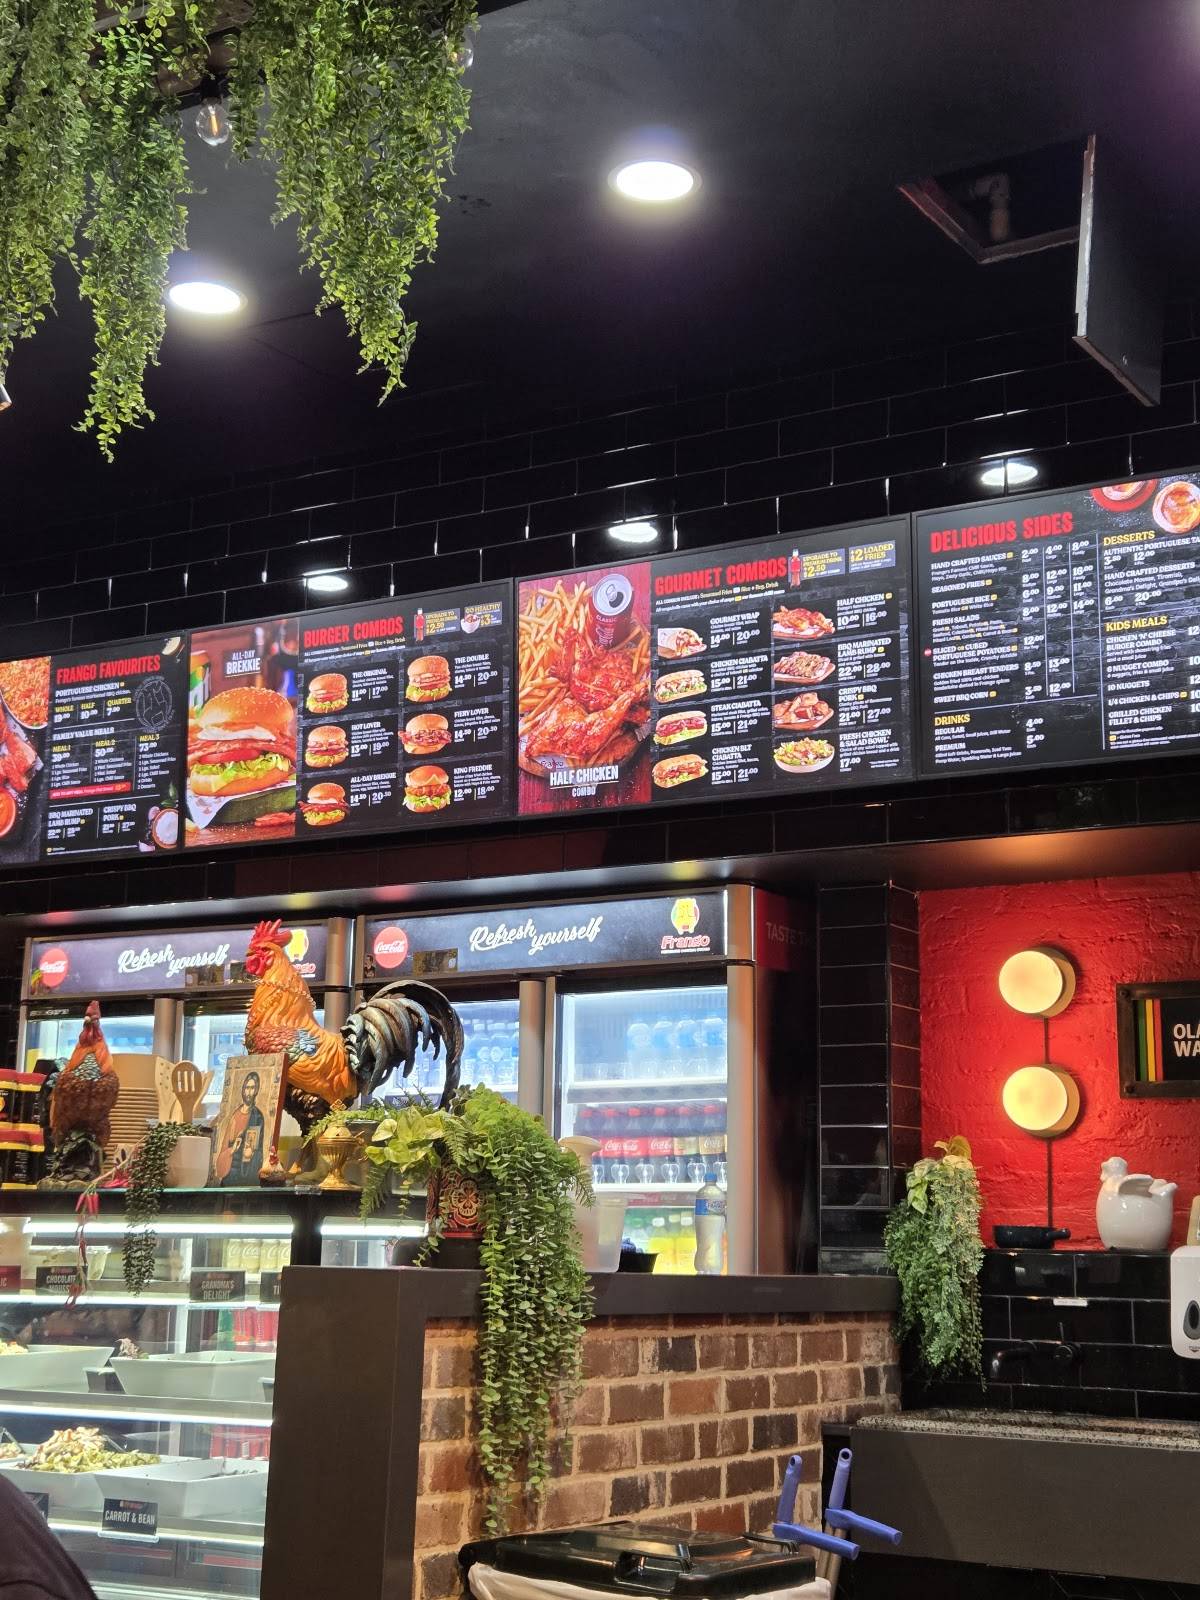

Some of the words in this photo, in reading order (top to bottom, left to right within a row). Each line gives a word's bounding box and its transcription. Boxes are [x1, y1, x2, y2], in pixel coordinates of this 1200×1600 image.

[931, 521, 1016, 553] DELICIOUS
[1023, 512, 1072, 538] SIDES
[1103, 530, 1154, 546] DESSERTS
[864, 543, 893, 553] LOADED
[1104, 544, 1143, 556] AUTHENTIC
[1144, 537, 1190, 550] PORTUGUESE
[864, 551, 885, 560] FRIES
[931, 561, 949, 569] HAND
[951, 556, 979, 566] CRAFTED
[981, 552, 1005, 562] SAUCES
[656, 567, 722, 595] GOURMET
[726, 556, 787, 585] COMBOS
[1104, 571, 1124, 580] HAND
[1126, 566, 1157, 577] CRAFTED
[1159, 561, 1195, 572] DESSERTS
[931, 582, 965, 593] SEASONED
[837, 598, 854, 606] HALF
[855, 593, 884, 603] CHICKEN
[710, 614, 740, 625] GOURMET
[741, 611, 759, 620] WRAP
[837, 614, 858, 626] 10.00
[865, 610, 886, 622] 16.00
[932, 617, 952, 626] FRESH
[1106, 620, 1130, 631] KIDS
[1132, 615, 1167, 628] MEALS
[304, 625, 349, 648] BURGER
[354, 616, 403, 640] COMBOS
[736, 629, 759, 640] 20.00
[1106, 633, 1136, 643] CHICKEN
[1148, 629, 1175, 638] CHEESE
[852, 637, 890, 648] MARINATED
[933, 645, 956, 654] SLICED
[965, 641, 987, 650] CUBED
[1106, 641, 1134, 650] BURGER
[1135, 638, 1162, 647] COMBO
[232, 650, 255, 660] ALL-DAY
[976, 645, 1010, 655] POTATOES
[227, 658, 260, 674] BREKKIE
[711, 658, 737, 668] CHICKEN
[866, 661, 890, 673] 28.00
[1113, 662, 1140, 671] NUGGET
[1142, 659, 1168, 668] COMBO
[56, 665, 96, 684] FRANGO
[100, 655, 160, 679] FAVOURITES
[838, 665, 862, 676] 22.00
[933, 670, 961, 679] CHICKEN
[737, 674, 756, 685] 21.00
[1116, 680, 1149, 690] NUGGETS
[838, 686, 861, 695] CRISPY
[838, 694, 857, 702] PORK
[934, 695, 954, 703] SWEET
[1118, 695, 1150, 704] CHICKEN
[711, 703, 731, 712] STEAK
[867, 707, 890, 718] 27.00
[1108, 709, 1138, 718] GRILLED
[1139, 705, 1171, 714] CHICKEN
[737, 719, 757, 729] 21.00
[934, 713, 970, 725] DRINKS
[839, 732, 860, 740] FRESH
[862, 729, 891, 738] CHICKEN
[935, 726, 964, 735] REGULAR
[844, 738, 866, 747] SALAD
[935, 742, 965, 751] PREMIUM
[839, 757, 860, 768] 17.00
[550, 769, 575, 786] HALF
[577, 765, 618, 783] CHICKEN
[737, 767, 757, 778] 21.00
[572, 786, 596, 797] COMBO
[469, 918, 536, 952] Refresh
[530, 916, 604, 954] yourself
[661, 935, 710, 950] Frango
[118, 944, 175, 974] Refresh
[168, 944, 230, 978] yourself
[50, 1284, 70, 1292] MOUSS
[202, 1280, 235, 1290] GRANDMA'S
[204, 1289, 231, 1300] DELIGHT
[105, 1510, 130, 1522] CARROT
[138, 1513, 155, 1525] BEAN
